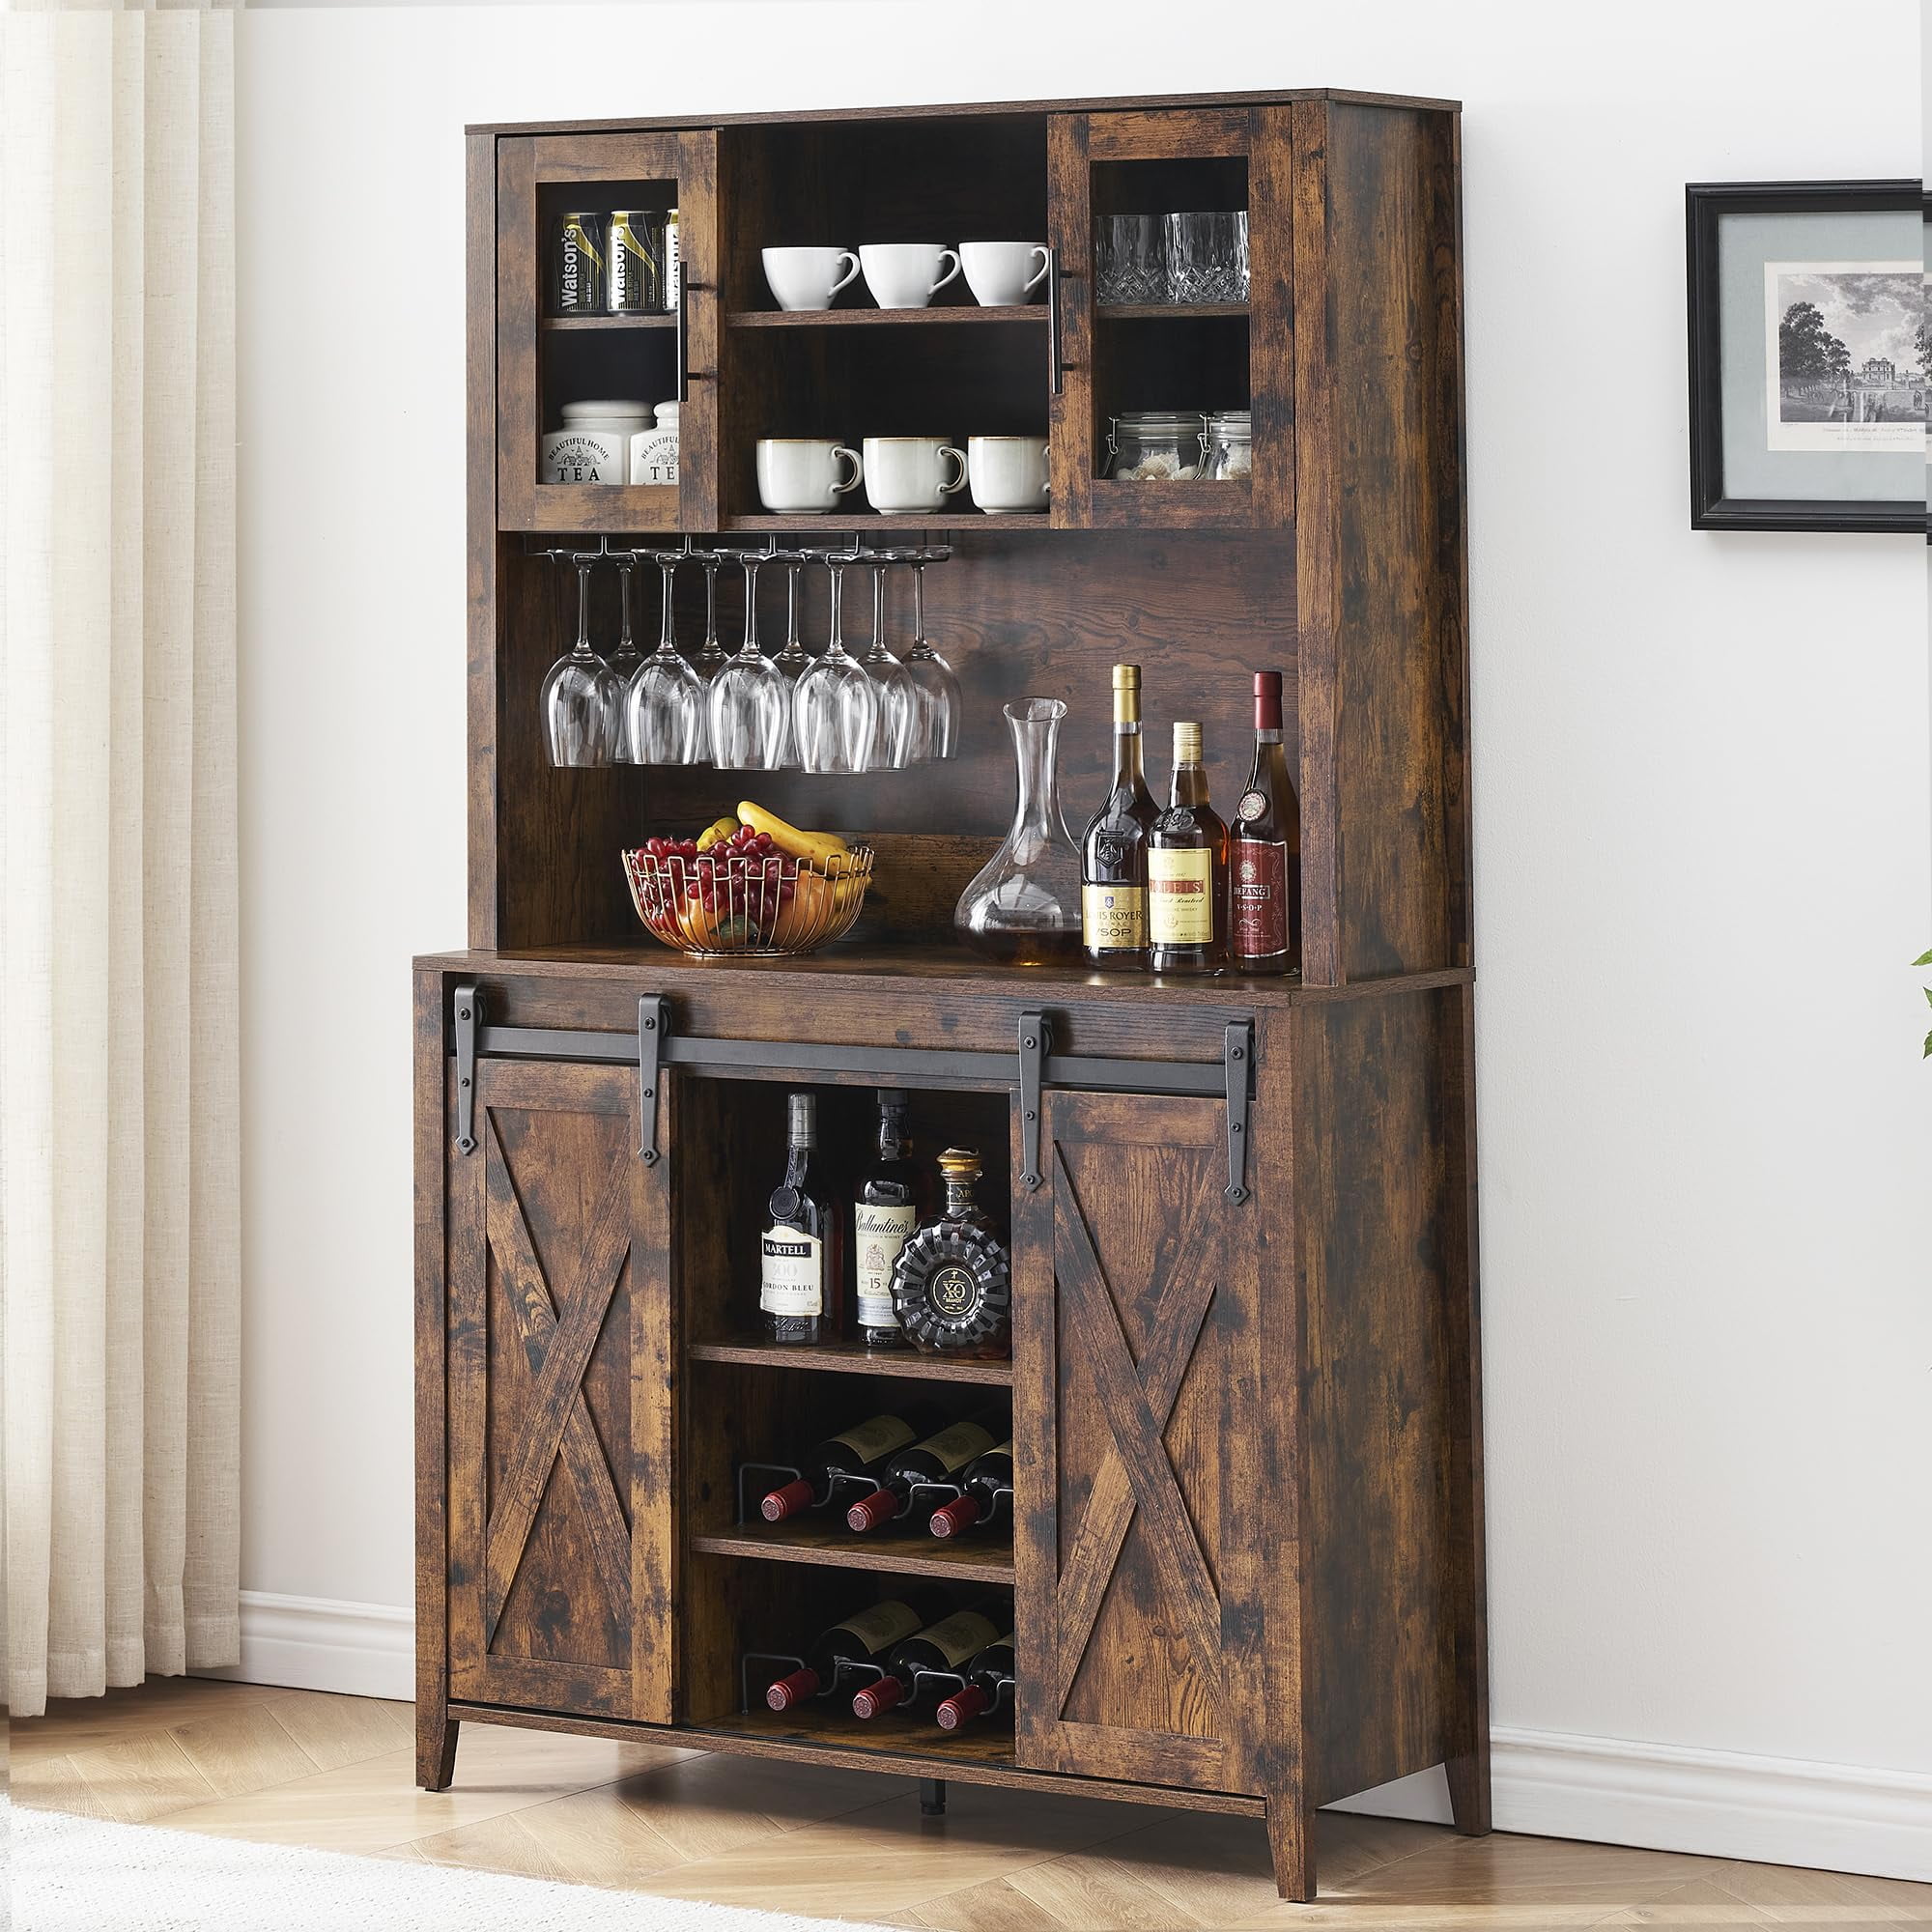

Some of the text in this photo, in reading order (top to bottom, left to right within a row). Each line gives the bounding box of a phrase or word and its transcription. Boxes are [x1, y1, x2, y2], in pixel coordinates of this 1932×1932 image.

[561, 226, 578, 307] Watson's
[548, 438, 610, 461] BEAUTIFUL HOME
[557, 468, 600, 481] TEA
[650, 466, 675, 480] TE
[1110, 910, 1143, 920] ROYER
[856, 1208, 908, 1234] Ballantine's
[765, 1242, 807, 1255] MARTELL
[869, 1277, 881, 1290] 15
[942, 1283, 966, 1299] XO
